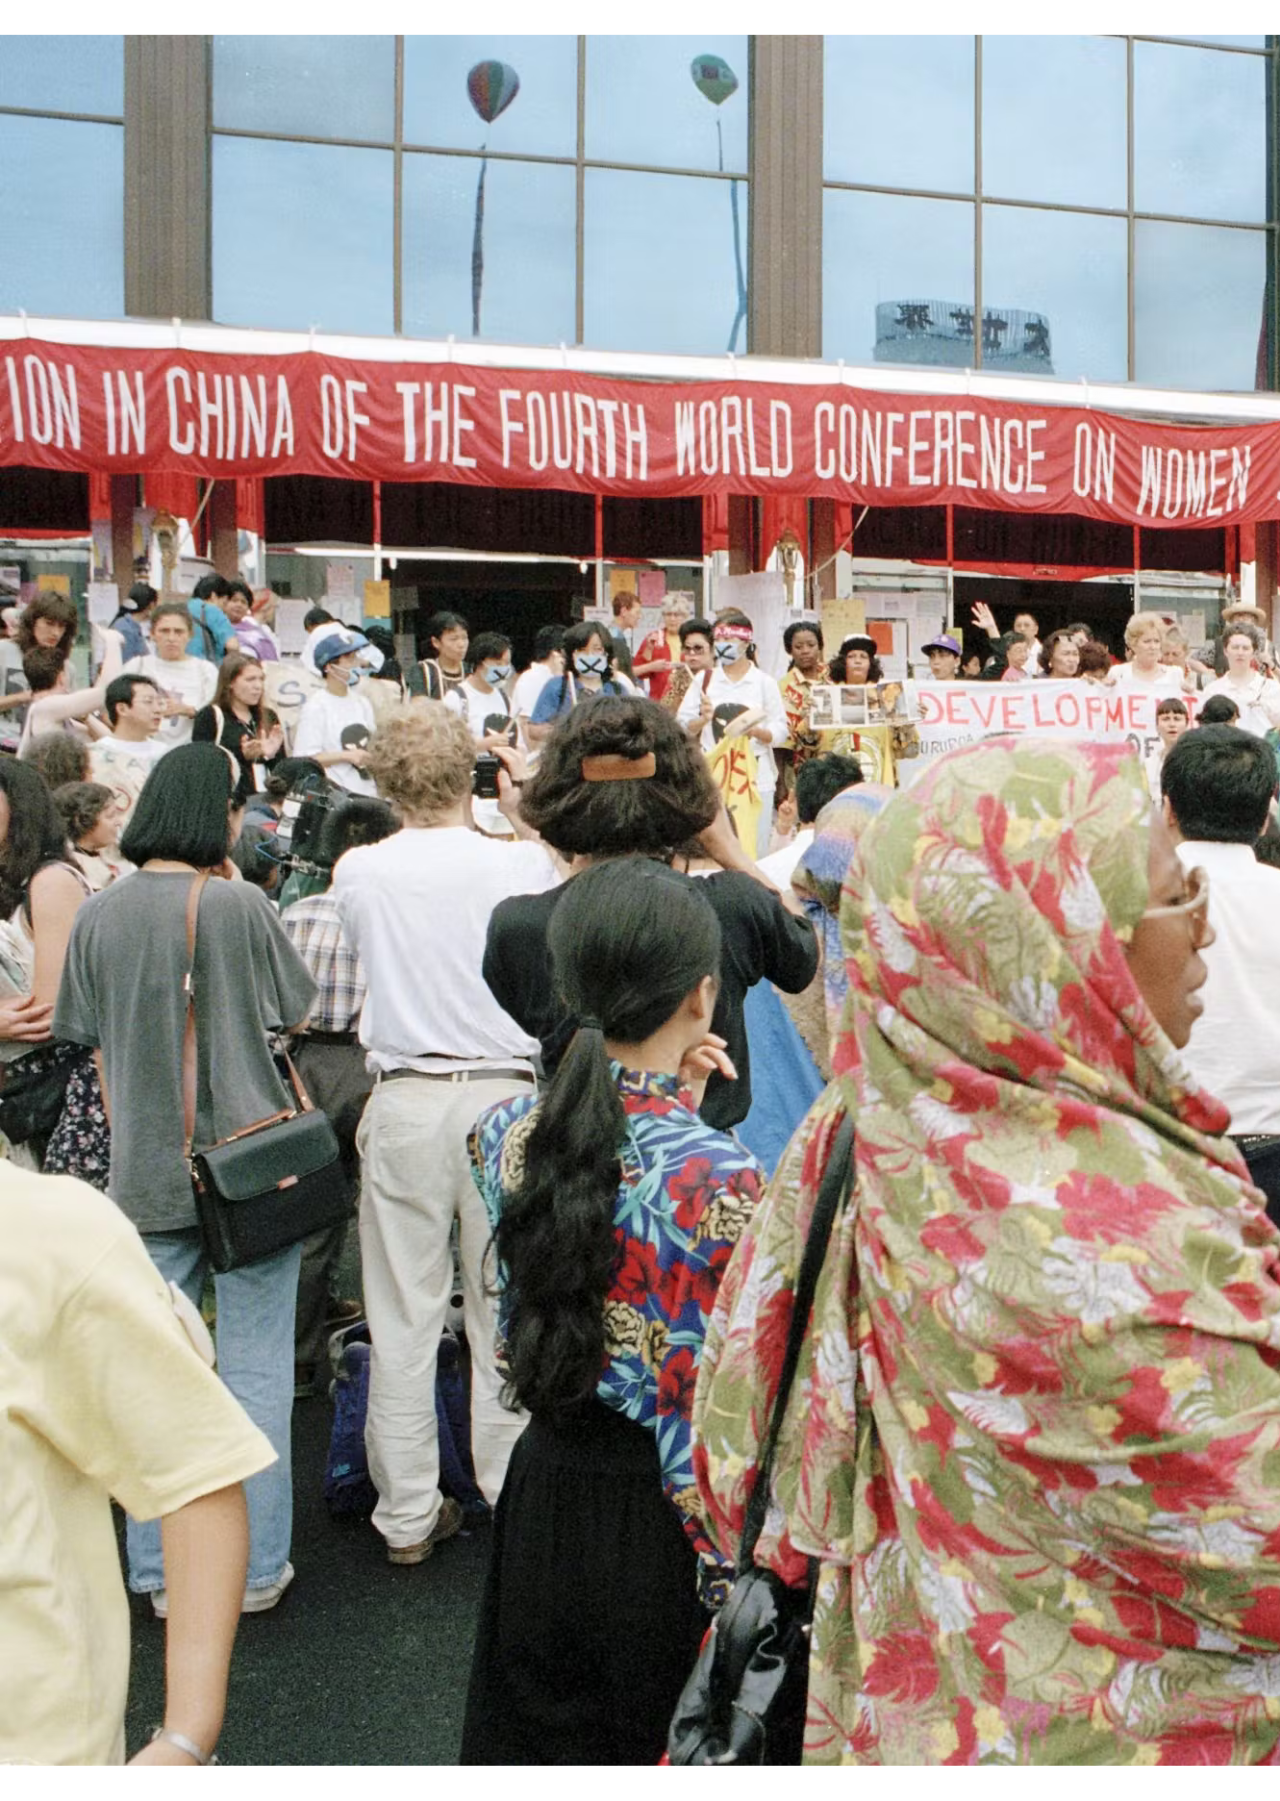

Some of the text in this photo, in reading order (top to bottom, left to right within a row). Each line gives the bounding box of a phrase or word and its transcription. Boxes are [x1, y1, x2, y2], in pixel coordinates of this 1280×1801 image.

[3, 353, 82, 450] ION
[102, 369, 147, 456] IN
[165, 365, 295, 461] CHINA
[320, 373, 371, 462] OF
[395, 381, 478, 469] THE
[498, 388, 649, 481] FOURTH
[674, 394, 794, 478] WORLD
[813, 400, 1048, 494] CONFERENCE
[1072, 422, 1117, 505] ON
[1135, 444, 1252, 519] WOMEN
[917, 690, 1199, 732] DEVELOPMET
